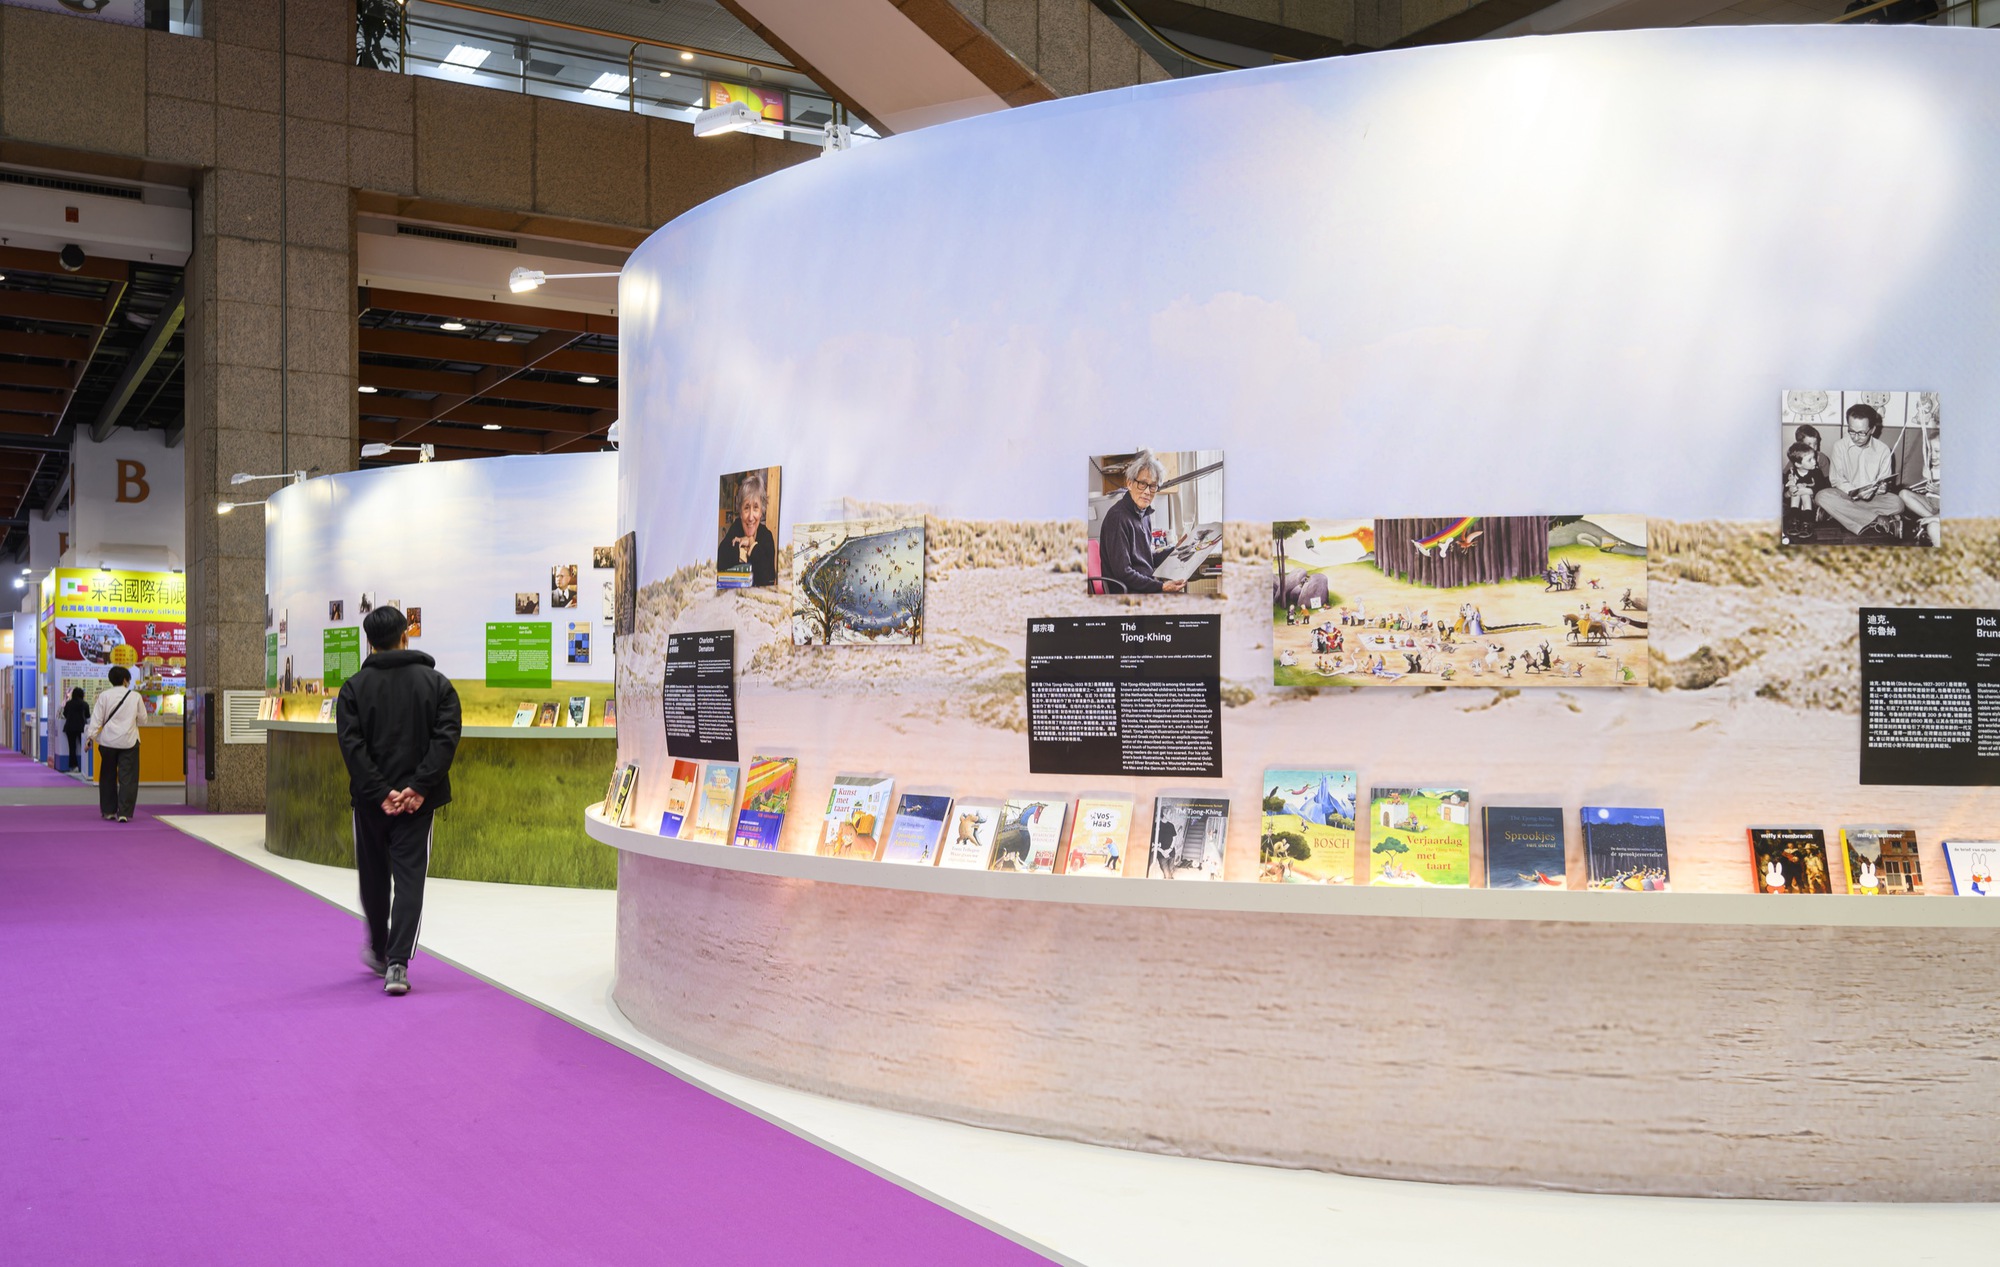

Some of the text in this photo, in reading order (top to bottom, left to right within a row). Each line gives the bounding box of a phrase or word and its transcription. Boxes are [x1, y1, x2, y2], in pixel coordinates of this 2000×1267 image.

[115, 459, 150, 503] B
[1121, 622, 1136, 631] Thé
[1976, 617, 1996, 626] Dick
[1868, 626, 1896, 636] 布魯納
[1121, 633, 1172, 643] Tjong-Khing
[838, 788, 857, 796] Kunst
[1187, 808, 1222, 816] Tjong-Khing
[1407, 836, 1462, 846] Verjaardag
[1504, 831, 1556, 843] Sprookjes
[1314, 838, 1350, 848] BOSCH
[1427, 862, 1451, 870] taart
